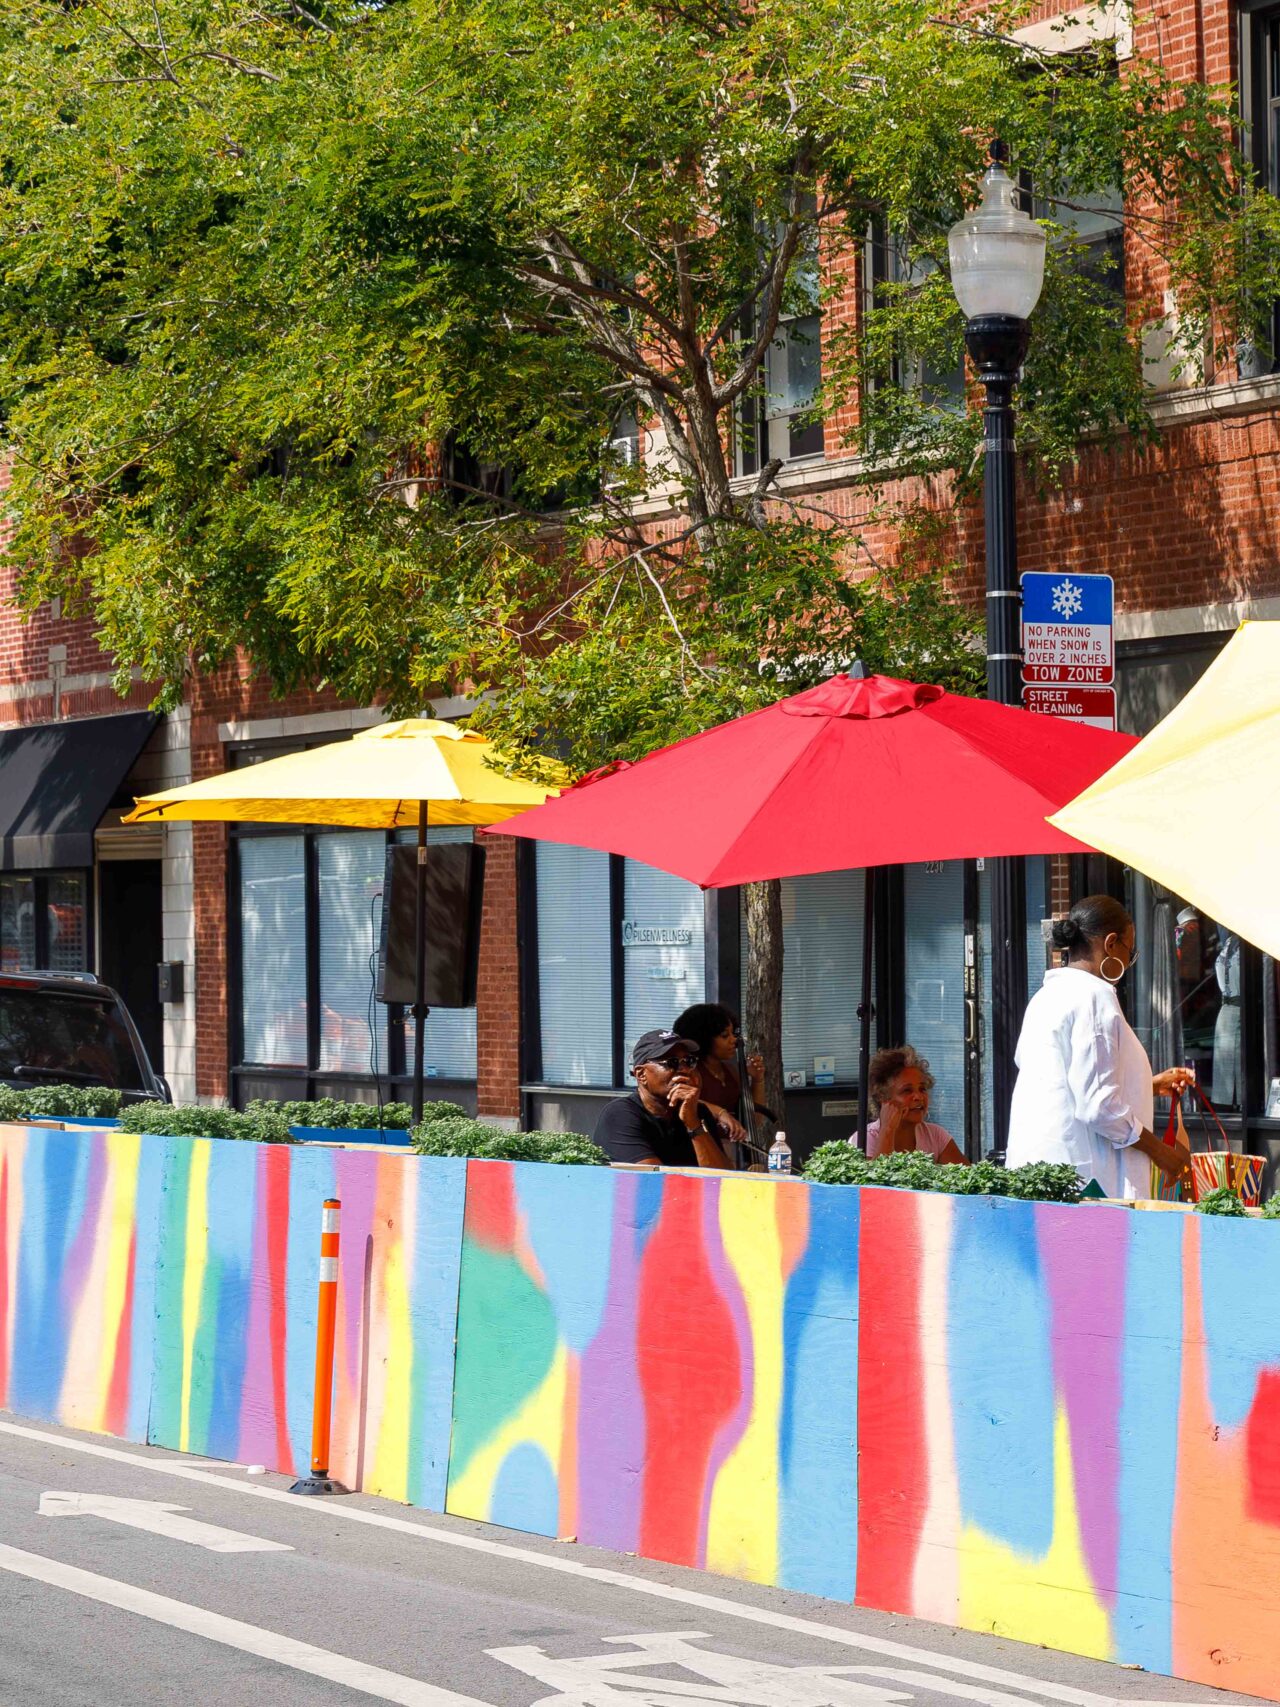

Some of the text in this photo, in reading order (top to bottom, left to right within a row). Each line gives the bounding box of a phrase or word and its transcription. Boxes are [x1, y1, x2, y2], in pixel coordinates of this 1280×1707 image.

[1028, 625, 1091, 637] NO PARKING
[1028, 639, 1102, 651] WHEN SNOW IS
[1028, 653, 1107, 664] OVER 2 INCHES
[1031, 666, 1104, 682] TOW ZONE
[1029, 690, 1069, 702] STREET
[1029, 703, 1083, 714] CLEANING
